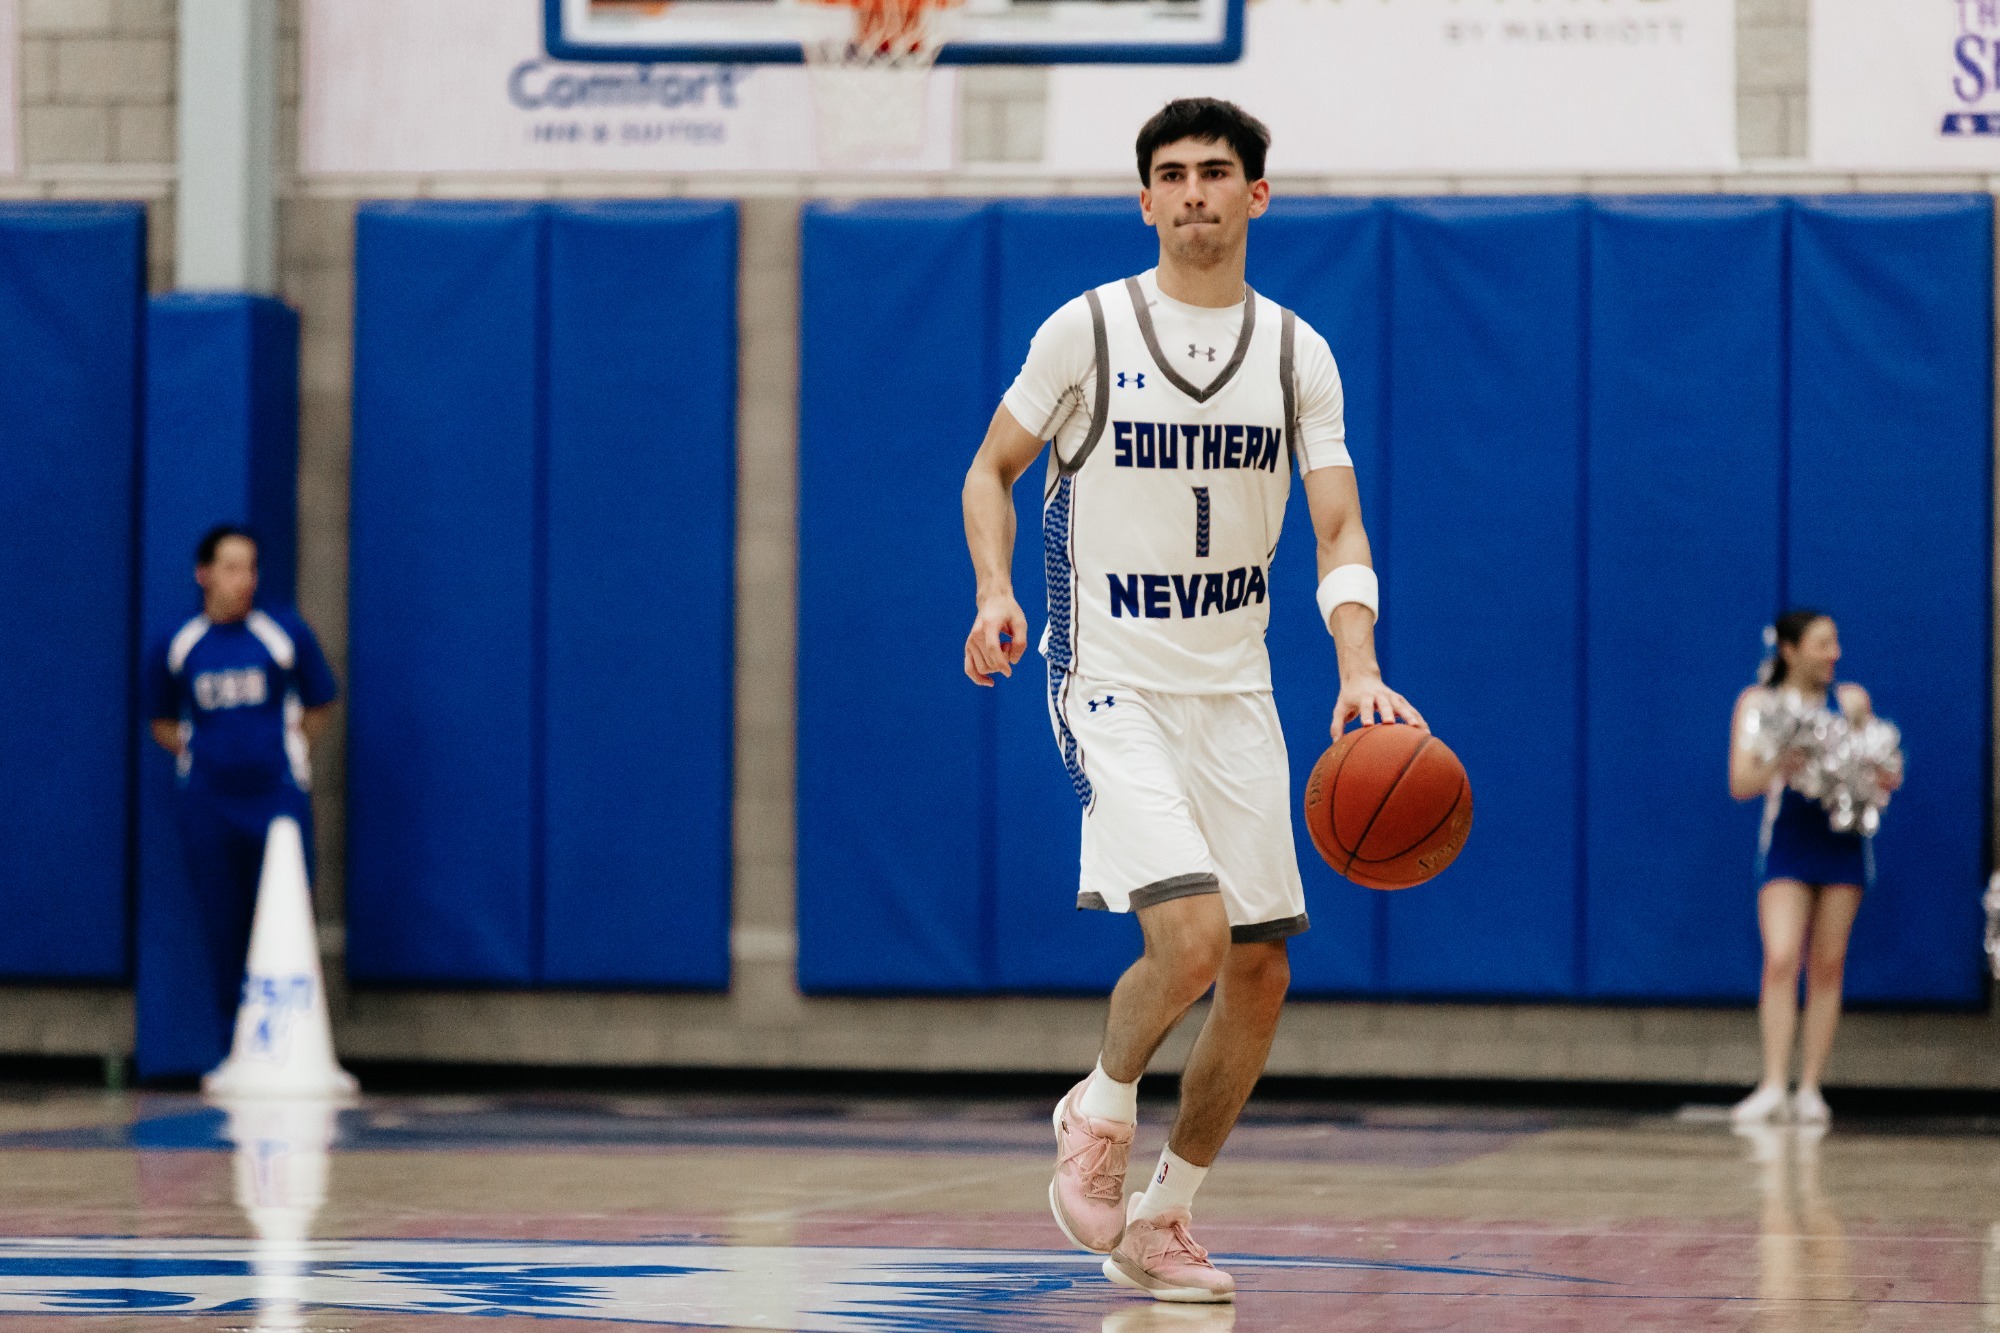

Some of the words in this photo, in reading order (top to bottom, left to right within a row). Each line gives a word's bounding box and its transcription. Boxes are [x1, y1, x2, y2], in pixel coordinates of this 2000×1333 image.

[508, 60, 738, 109] Comfort
[1113, 420, 1281, 473] SOUTHERN
[1191, 486, 1210, 557] 1
[1106, 566, 1266, 620] NEVADA
